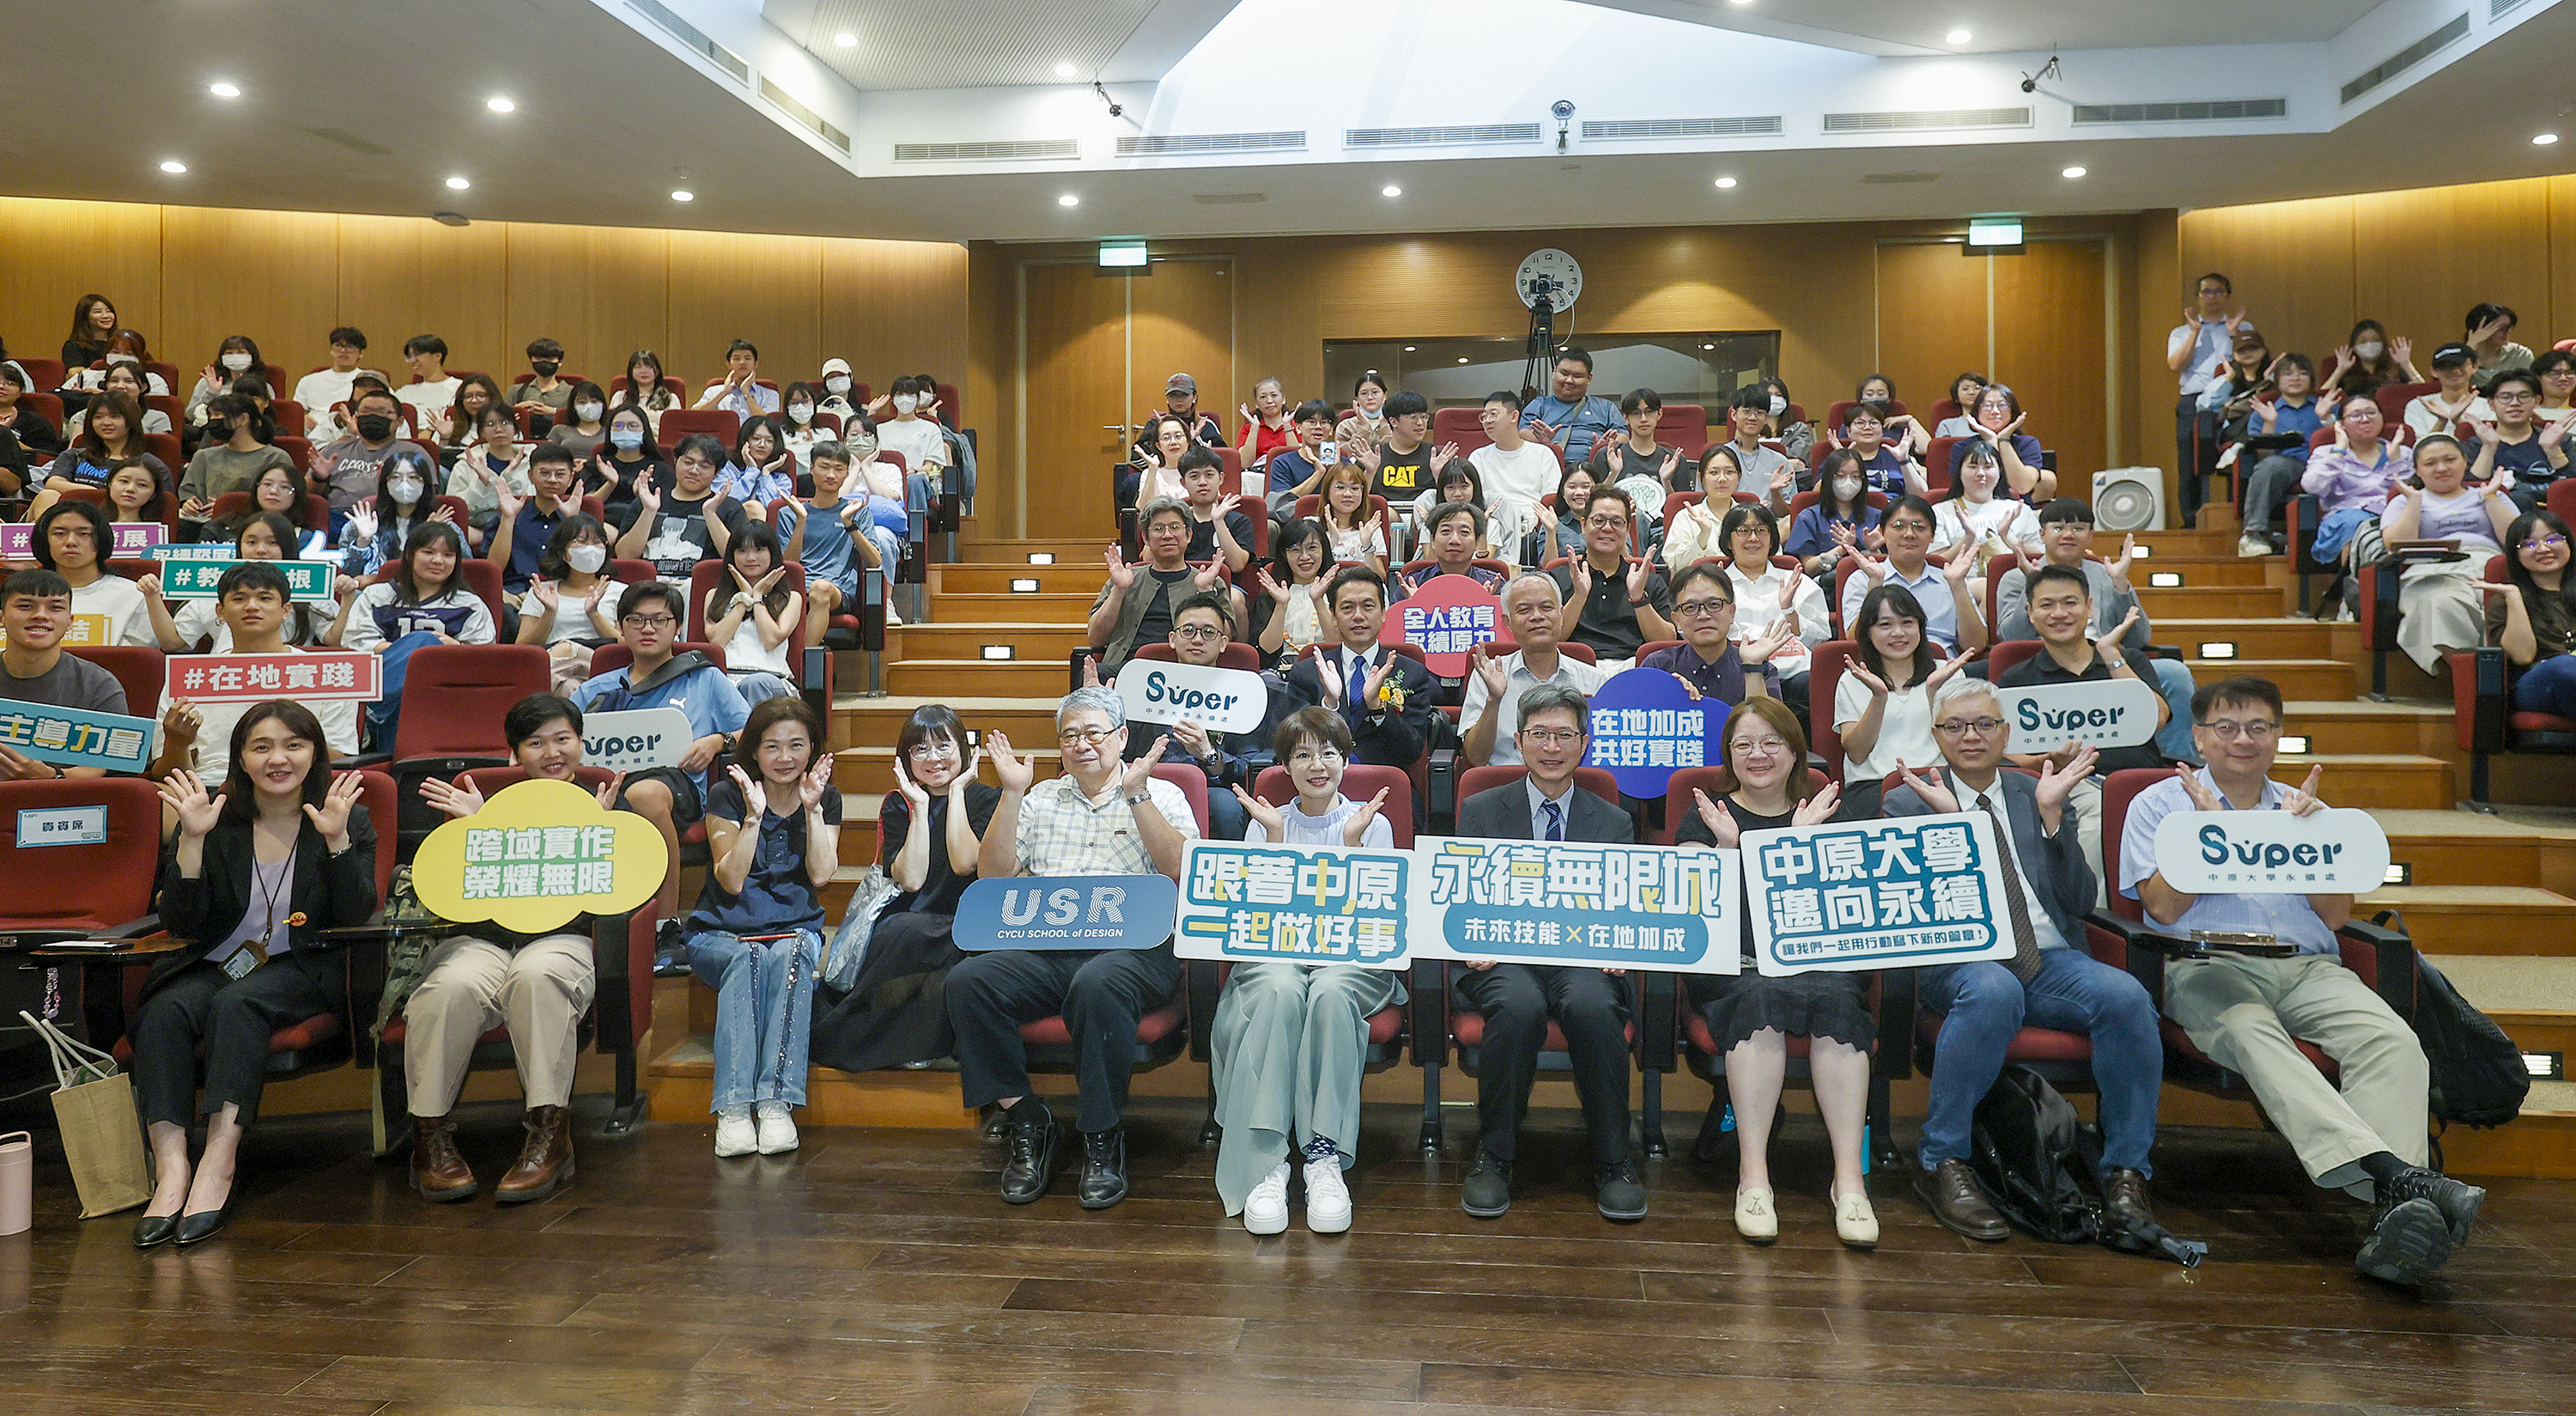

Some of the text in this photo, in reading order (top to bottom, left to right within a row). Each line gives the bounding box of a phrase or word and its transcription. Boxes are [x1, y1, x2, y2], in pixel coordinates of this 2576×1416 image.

[1383, 465, 1415, 487] CAT
[1403, 605, 1495, 629] 全人教育
[183, 662, 355, 691] #在地實踐
[1145, 671, 1238, 711] Super
[1145, 708, 1229, 723] 中原大學永續處
[1591, 708, 1704, 737] 在地加成
[2017, 697, 2124, 731] Super
[0, 712, 144, 759] 主導力量
[582, 733, 661, 757] uper
[1591, 738, 1704, 767] 共好實踐
[2024, 732, 2118, 744] 中原大學永續處
[465, 825, 616, 862] 跨域實作
[1763, 825, 1974, 885] 中原大學
[2199, 824, 2342, 868] Super
[463, 860, 614, 899] 榮耀無限
[1191, 852, 1400, 915] 跟著中原
[1431, 842, 1721, 918] 永續無限城
[2208, 872, 2336, 882] 中原大學永續處
[1000, 886, 1127, 927] USR
[1769, 873, 1986, 935] 邁向永續
[997, 928, 1124, 939] CYCU SCHOOL of DESIGN
[1187, 909, 1399, 957] 一起做好事
